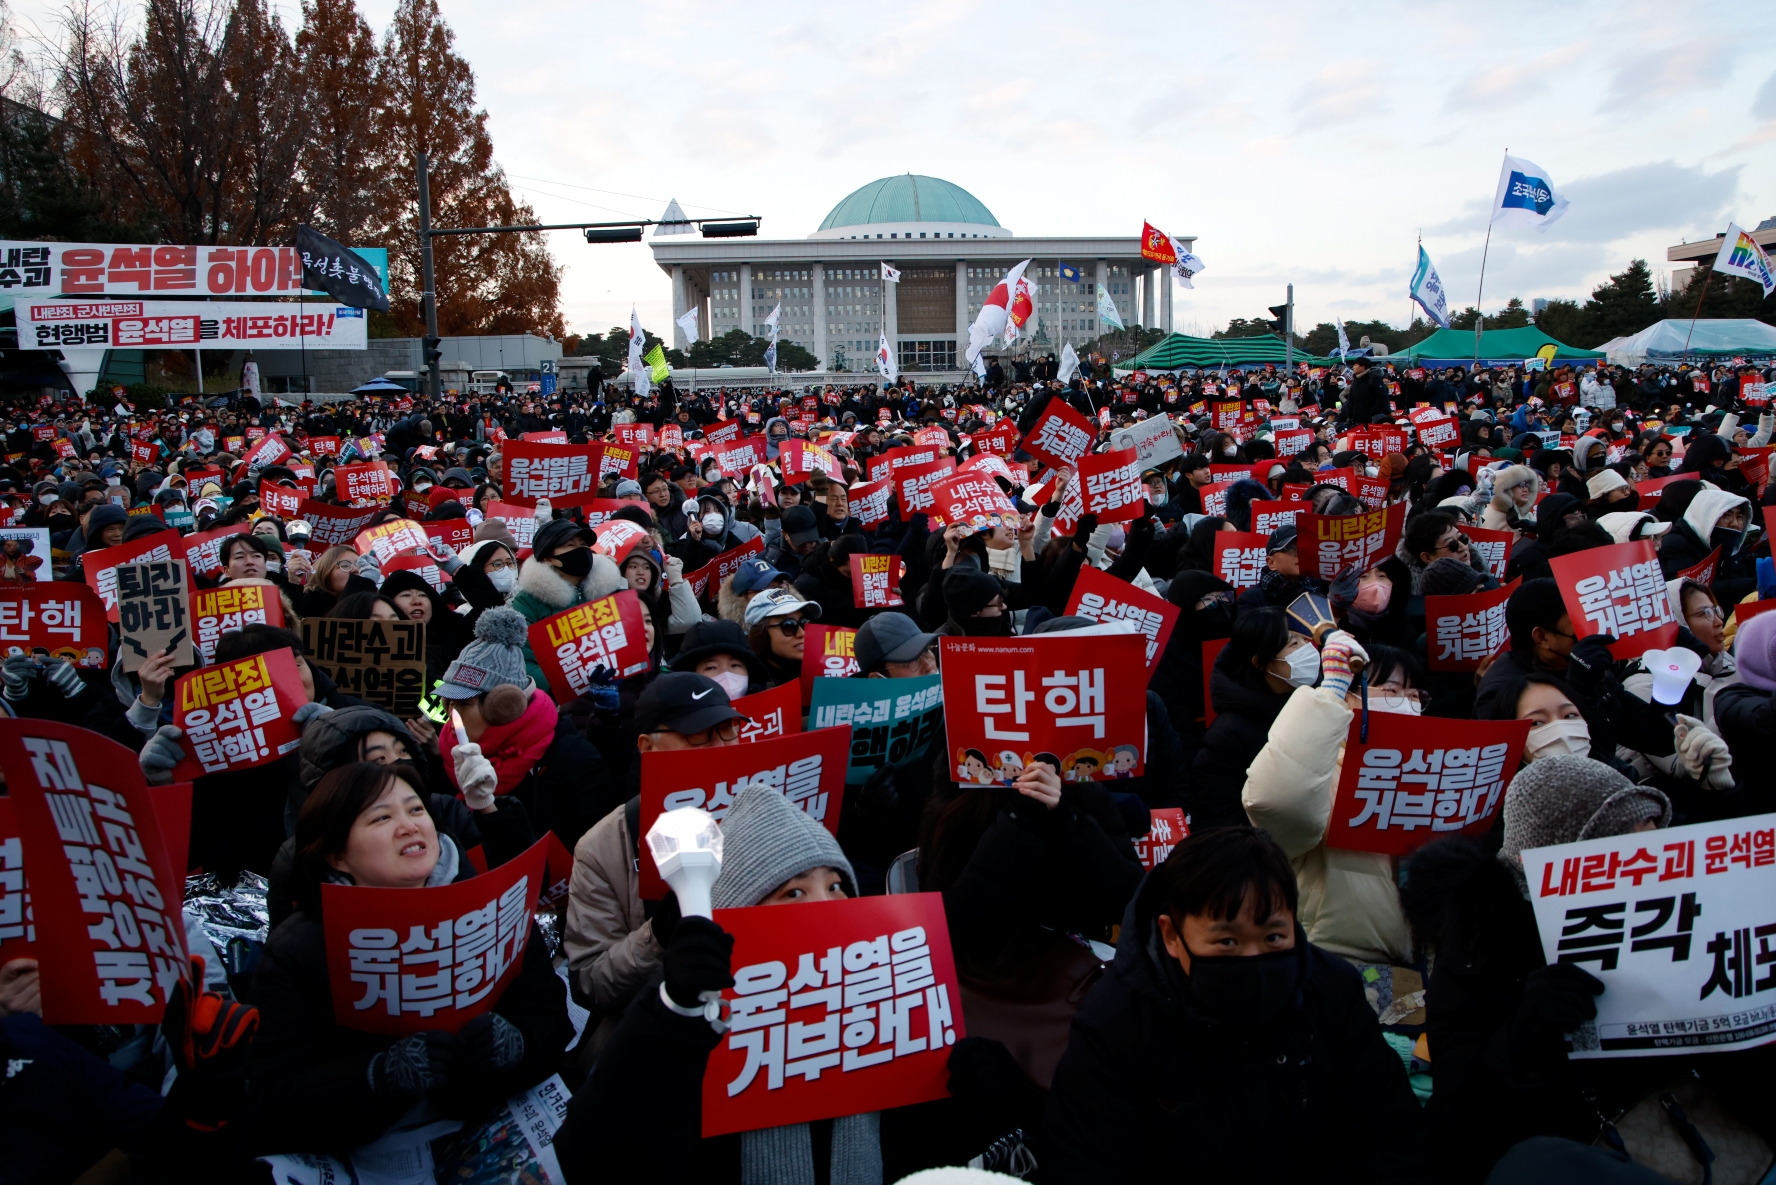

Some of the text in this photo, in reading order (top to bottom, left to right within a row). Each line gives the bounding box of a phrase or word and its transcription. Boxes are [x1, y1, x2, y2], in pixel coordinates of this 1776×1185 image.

[0, 247, 51, 268] 내란
[61, 246, 197, 293] 윤석열
[0, 267, 52, 288] 수괴
[34, 303, 140, 320] 내란죄, 군사반란죄
[36, 313, 336, 346] 현행범 윤석열을 체포하라!
[544, 363, 554, 377] 2
[1219, 402, 1241, 412] 내란죄
[1219, 411, 1241, 422] 윤석열
[622, 429, 648, 444] 탄핵
[979, 436, 1007, 454] 탄핵
[1043, 415, 1091, 458] 윤석열을
[1278, 434, 1310, 449] 윤석열을
[1420, 422, 1455, 443] 윤석열을
[314, 441, 336, 454] 탄핵
[604, 446, 632, 461] 내란죄
[718, 444, 756, 465] 윤석열을
[892, 450, 935, 469] 윤석열을
[1278, 443, 1305, 457] 거부한
[1355, 437, 1385, 457] 탄핵
[510, 455, 589, 481] 윤석열을
[601, 455, 629, 471] 윤석열
[347, 469, 387, 487] 윤석열을
[348, 481, 389, 499] 탄핵하라
[510, 473, 593, 499] 거부한다!
[1086, 459, 1142, 496] 김건희특
[264, 490, 299, 515] 탄핵
[848, 485, 891, 517] 윤석열을
[950, 497, 995, 520] 윤석열
[494, 516, 536, 539] 윤석열
[852, 503, 890, 528] 거부한
[1255, 509, 1305, 536] 윤석열
[1317, 513, 1387, 543] 내란죄
[310, 523, 362, 546] 진하라!
[1317, 530, 1387, 564] 윤석열
[860, 556, 890, 574] 내란죄
[120, 562, 182, 602] 퇴진
[862, 571, 890, 590] 윤석열
[1575, 558, 1667, 614] 윤석열을
[197, 586, 264, 618] 내란죄
[864, 587, 887, 608] 탄핵!
[0, 600, 82, 642] 탄핵
[120, 596, 186, 634] 하라
[198, 608, 265, 642] 윤석열
[546, 596, 621, 649] 내란죄
[303, 620, 425, 666] 내란수괴
[557, 620, 629, 673] 윤석열
[947, 642, 1035, 655] 나눔문화 www.nanum.com
[182, 654, 272, 712] 내란죄
[318, 667, 423, 717] 석열을
[184, 686, 282, 747] 윤석열
[815, 698, 893, 728] 내란수괴
[974, 667, 1105, 742] 탄핵
[193, 726, 271, 775] 탄핵!
[1356, 742, 1508, 794] 윤석열을
[1348, 779, 1506, 833] 거부한다!
[22, 736, 157, 1008] 채상병특검
[1539, 828, 1776, 898] 내란수괴 윤석열
[347, 875, 529, 976] 윤석열을
[1556, 892, 1702, 972] 즉각
[728, 925, 937, 1034] 윤석열을
[1626, 1022, 1662, 1037] 윤석열
[1664, 1018, 1710, 1035] 탄핵기금
[1712, 1016, 1732, 1031] 5억
[1733, 1012, 1750, 1028] 모금
[726, 983, 957, 1099] 거부한다!
[532, 1120, 554, 1149] 윤석열
